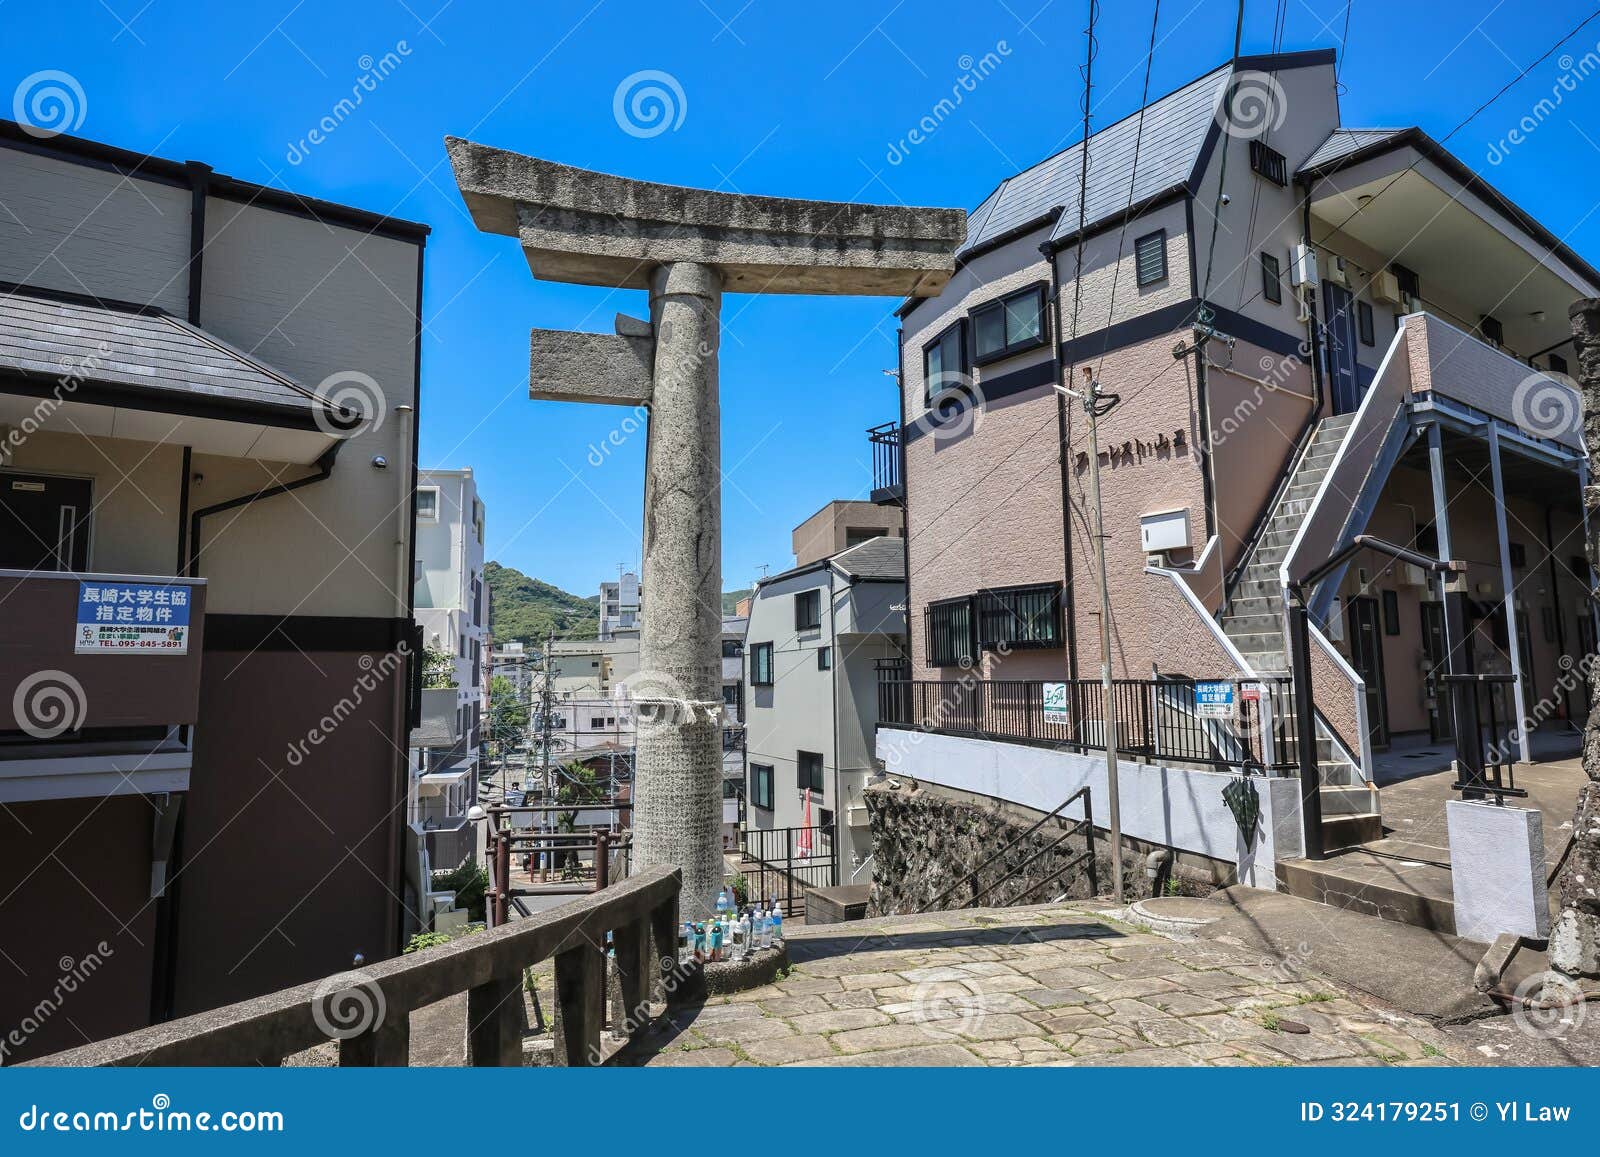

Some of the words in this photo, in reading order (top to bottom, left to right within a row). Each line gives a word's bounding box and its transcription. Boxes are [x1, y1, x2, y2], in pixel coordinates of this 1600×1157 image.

[82, 587, 187, 606] 長崎大学生協
[95, 605, 173, 622] 指定物件
[99, 640, 183, 648] TEL.095-845-5891
